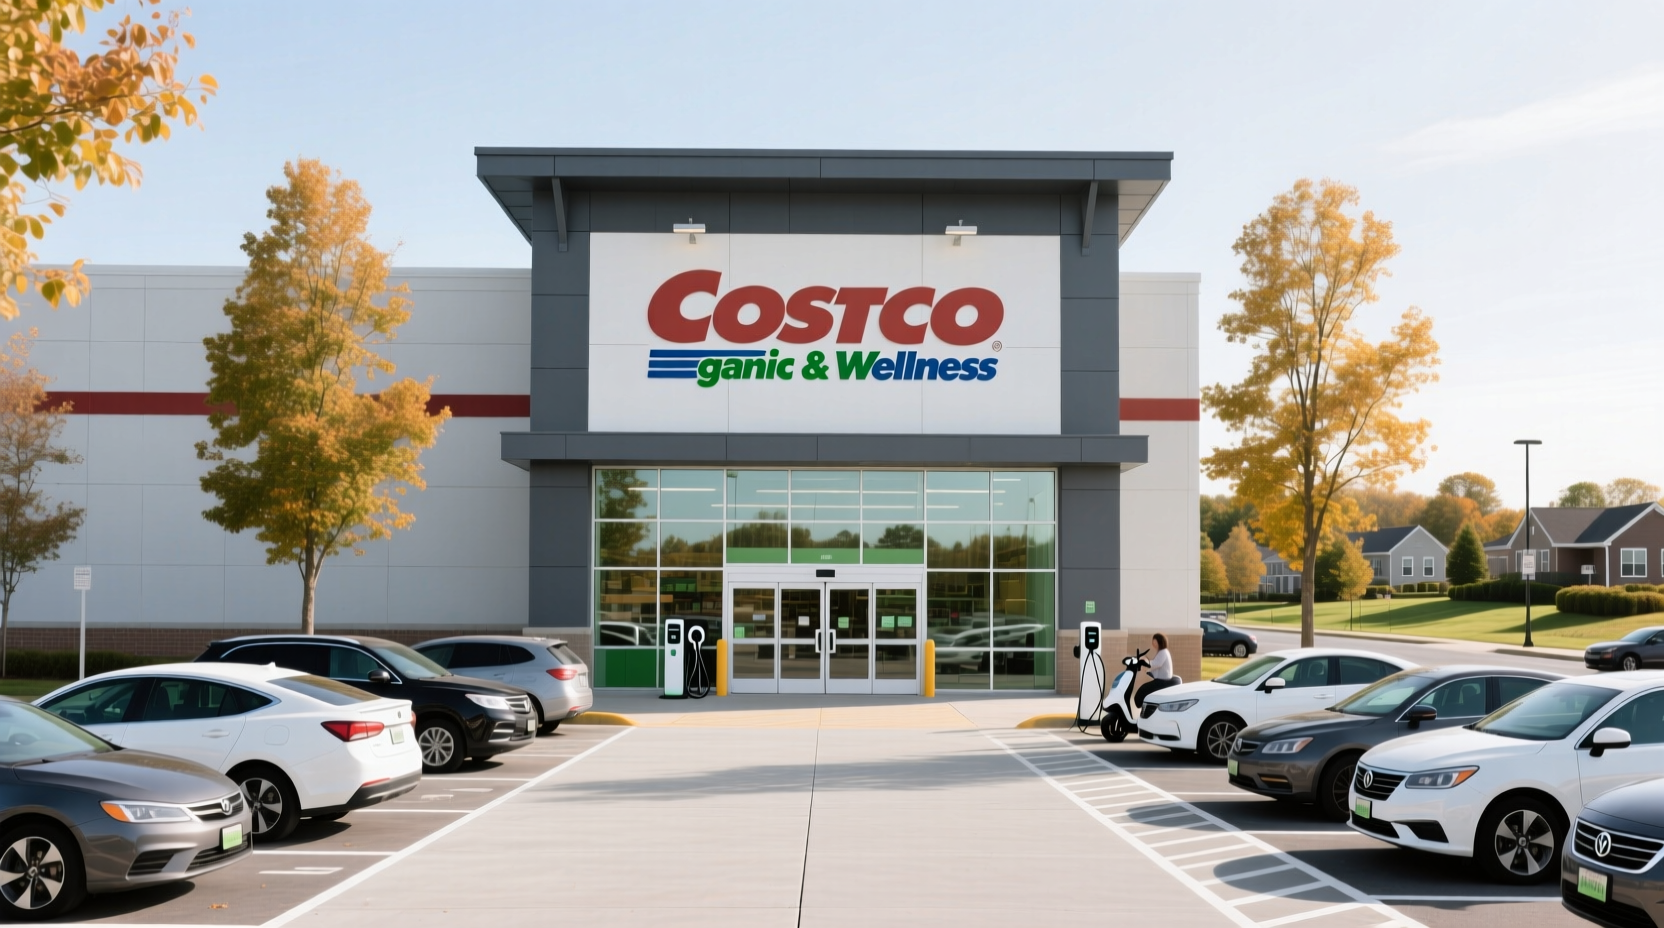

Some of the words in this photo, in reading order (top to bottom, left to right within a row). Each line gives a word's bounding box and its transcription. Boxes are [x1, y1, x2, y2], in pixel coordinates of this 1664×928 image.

[647, 269, 1004, 346] COSTCO
[697, 348, 795, 388] ganic
[802, 350, 829, 380] &
[836, 350, 998, 381] Wellness
